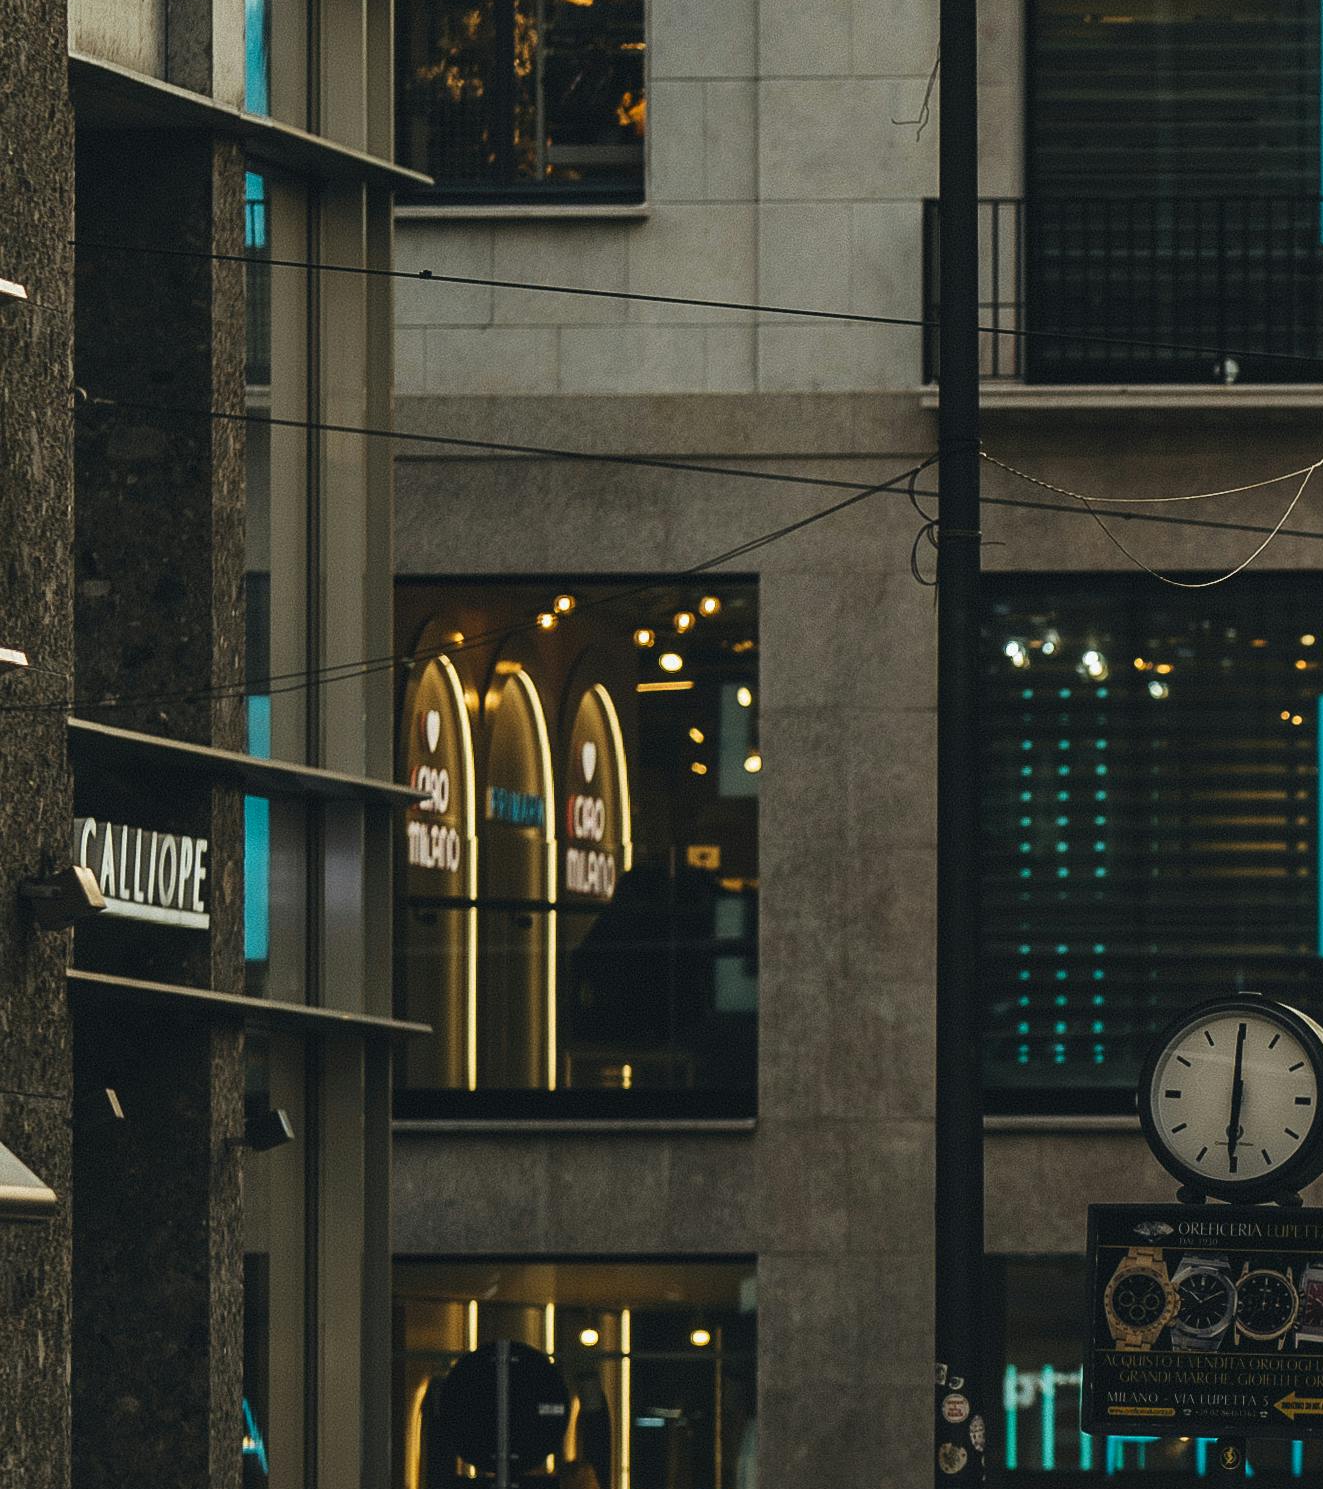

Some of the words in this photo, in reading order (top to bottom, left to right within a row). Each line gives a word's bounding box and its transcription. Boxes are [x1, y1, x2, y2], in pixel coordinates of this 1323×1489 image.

[80, 817, 208, 912] CALLIOPE
[1106, 1391, 1159, 1403] MILANO
[1174, 1392, 1195, 1404] VIA
